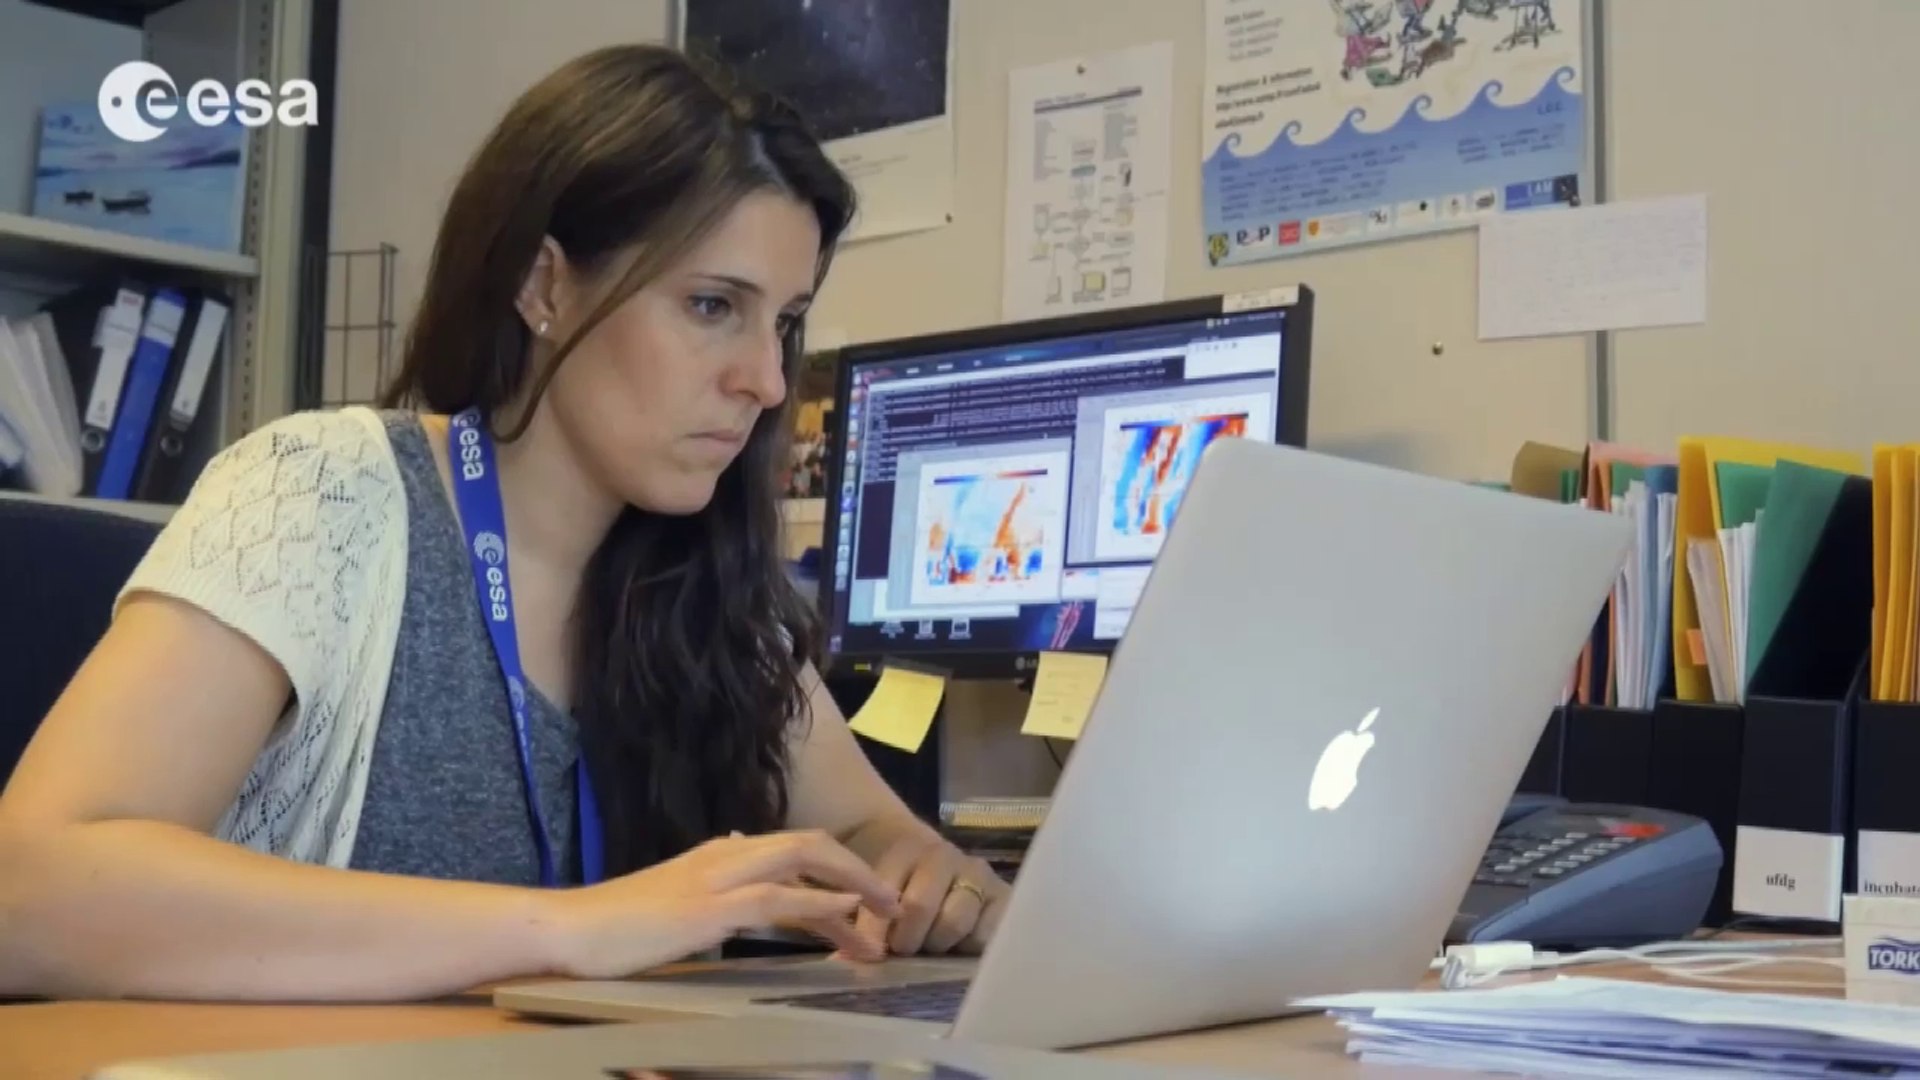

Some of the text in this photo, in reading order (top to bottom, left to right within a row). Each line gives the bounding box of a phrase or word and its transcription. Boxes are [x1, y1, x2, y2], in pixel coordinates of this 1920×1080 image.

[459, 427, 485, 481] esa
[486, 566, 509, 622] esa
[1766, 873, 1796, 891] ufdg
[1870, 949, 1920, 970] TORK
